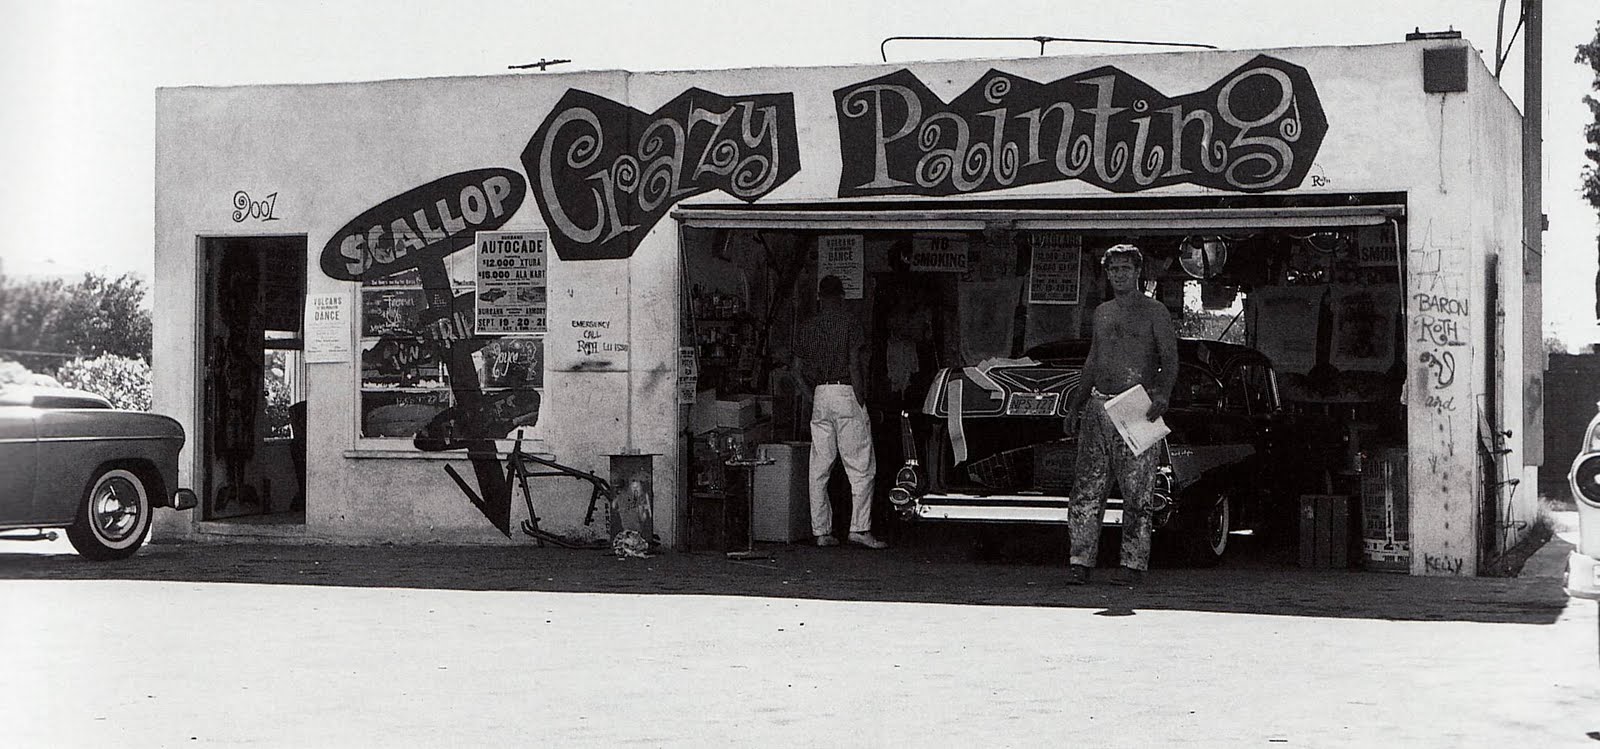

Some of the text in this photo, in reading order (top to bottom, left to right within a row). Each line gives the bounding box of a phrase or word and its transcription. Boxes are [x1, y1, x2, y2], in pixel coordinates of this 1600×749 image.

[541, 67, 1304, 243] Crazy Painting
[232, 190, 280, 222] 9001
[340, 176, 511, 275] SCALLOP
[481, 240, 543, 254] AUTOCADE
[931, 237, 949, 250] NO
[828, 251, 854, 262] DANCE
[913, 253, 966, 268] SMOKING
[1413, 293, 1468, 316] BARON
[314, 311, 340, 321] DANCE
[517, 318, 530, 326] 20
[571, 320, 610, 329] EMERGENCY
[583, 330, 601, 339] CALL
[492, 343, 519, 378] Joyce
[1425, 395, 1456, 412] and
